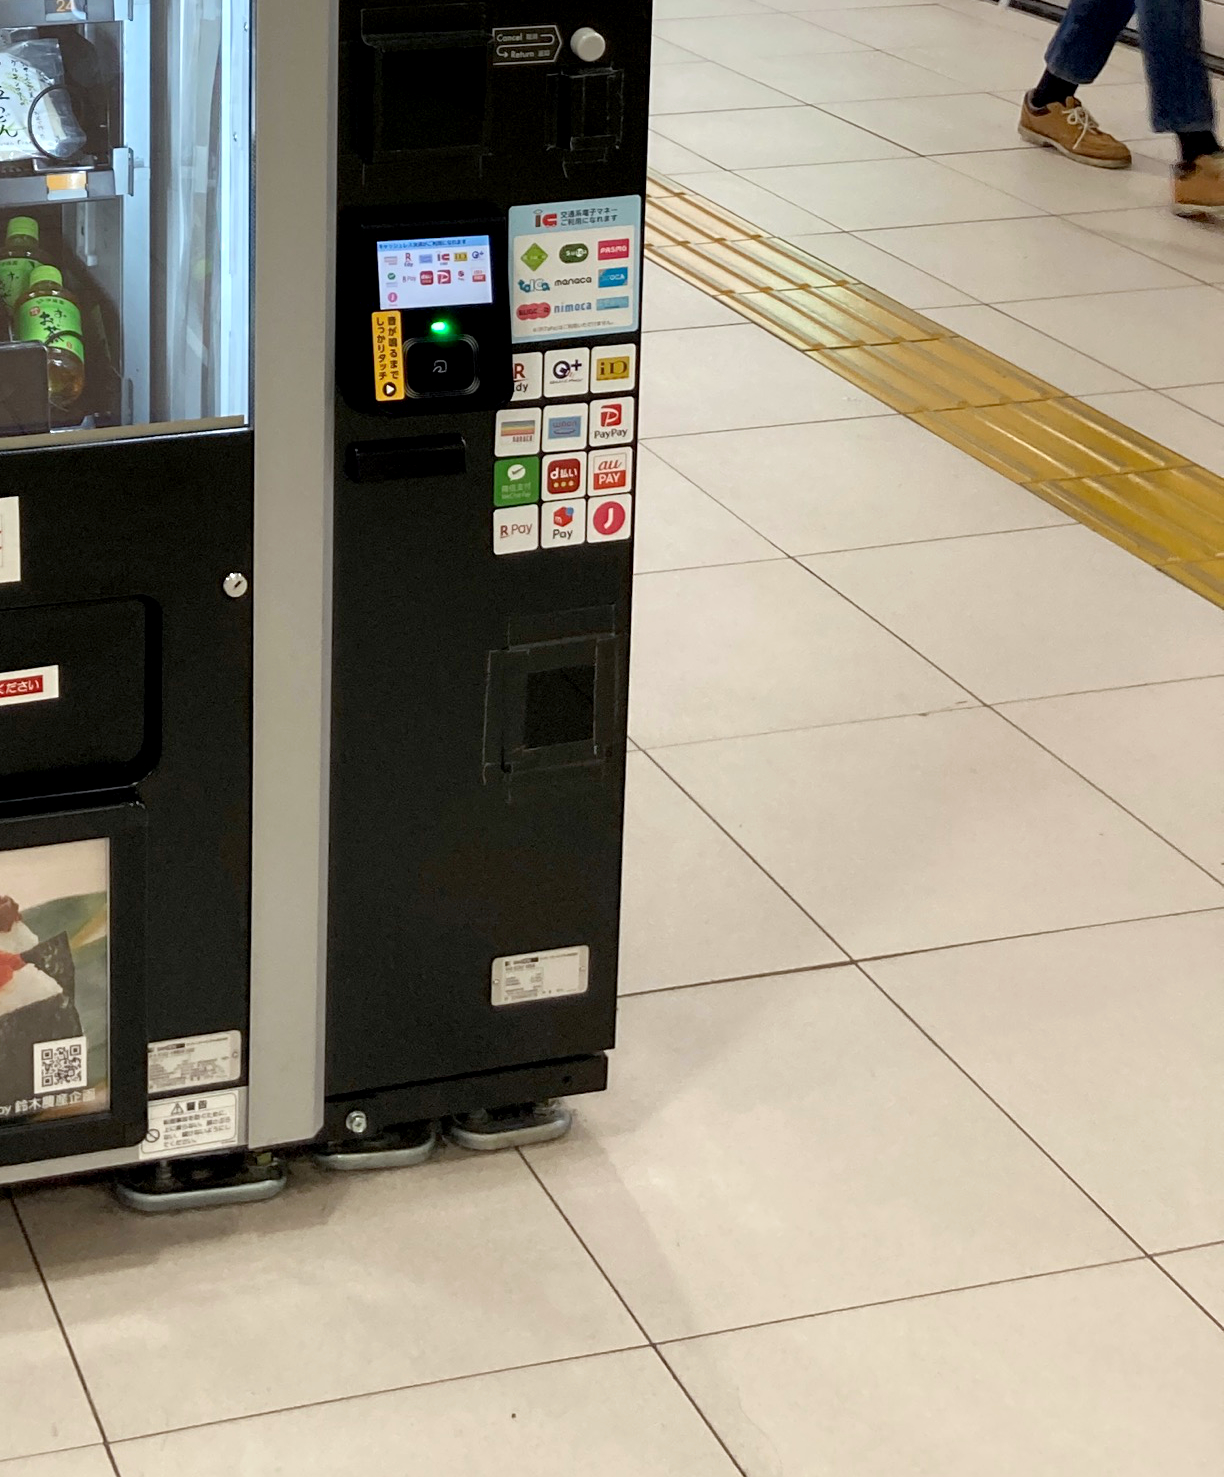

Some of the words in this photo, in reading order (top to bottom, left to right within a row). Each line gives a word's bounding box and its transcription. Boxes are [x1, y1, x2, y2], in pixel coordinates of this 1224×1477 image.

[497, 33, 522, 42] Cancel
[511, 50, 534, 58] Return
[561, 207, 617, 217] 交通系電子マネー
[561, 215, 617, 226] ご利用になれます
[600, 246, 627, 254] PASMO
[555, 277, 592, 286] manaca
[554, 302, 592, 313] nimoca
[377, 317, 387, 380] しっかりタッチ
[388, 317, 399, 379] 音が鳴るまで
[514, 363, 526, 380] R
[600, 361, 627, 375] iD
[594, 428, 628, 439] PayPay
[598, 460, 622, 471] au
[550, 468, 578, 479] d払い
[598, 472, 621, 485] PAY
[500, 525, 508, 537] R
[511, 524, 533, 535] Pay
[552, 528, 573, 539] Pay
[15, 1087, 96, 1113] 鈴木農産企画
